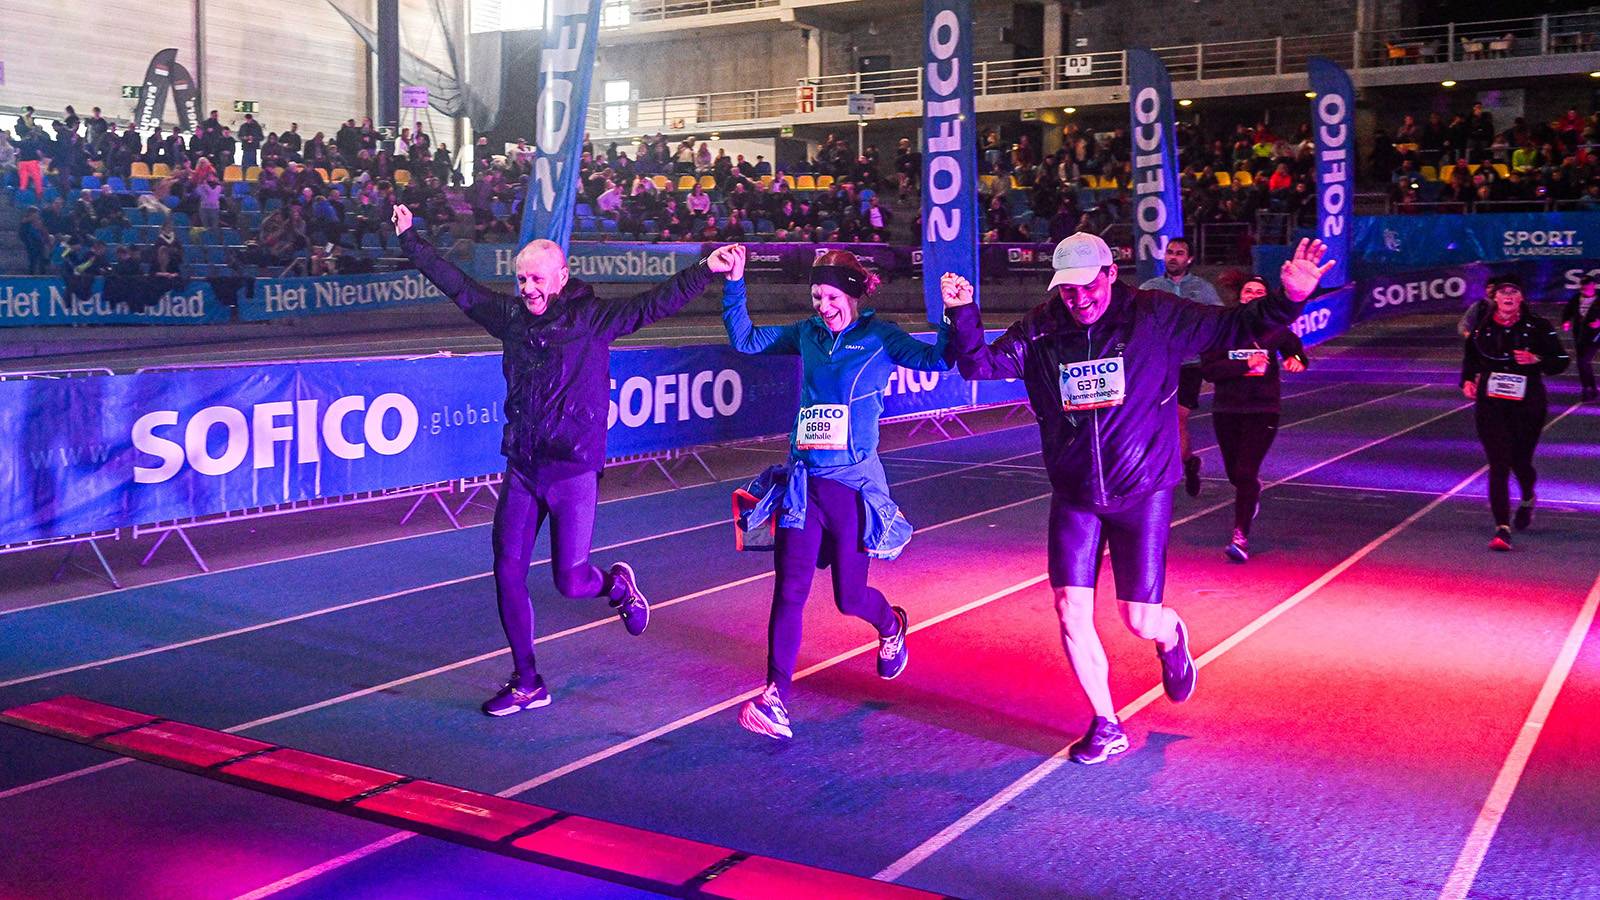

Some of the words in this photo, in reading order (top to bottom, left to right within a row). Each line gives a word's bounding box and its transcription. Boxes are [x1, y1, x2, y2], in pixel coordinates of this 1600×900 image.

[1503, 230, 1584, 246] SPORT.
[1502, 246, 1584, 256] VLAANDEREN
[568, 251, 677, 277] euwsblad
[264, 284, 308, 313] Het
[313, 274, 447, 308] Nieuwsbla
[1372, 276, 1467, 309] SOFICO
[1062, 361, 1119, 378] SOFICO
[1077, 377, 1106, 391] 6379
[800, 407, 844, 421] SOFICO
[805, 421, 831, 432] 6689
[131, 391, 419, 484] SOFICO
[804, 432, 832, 441] Nathalie
